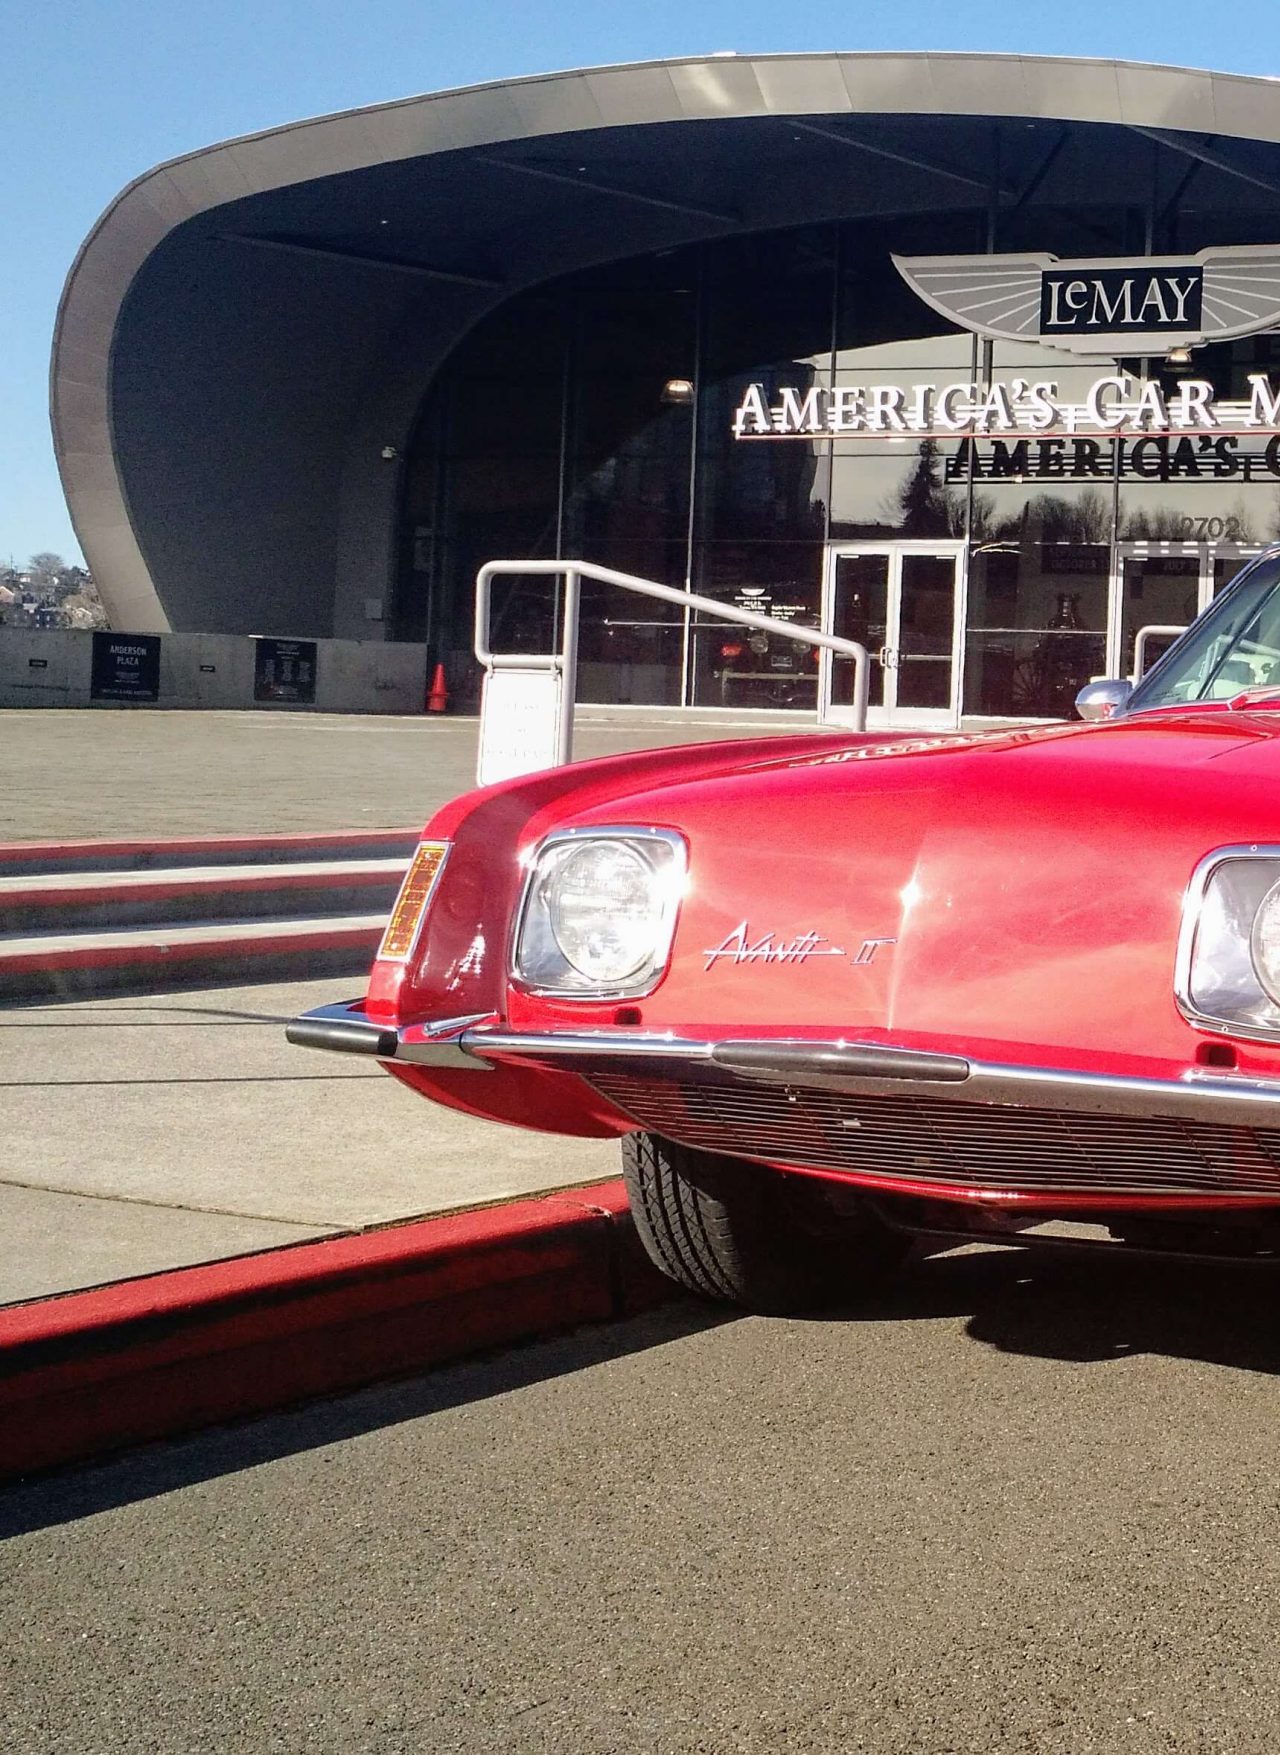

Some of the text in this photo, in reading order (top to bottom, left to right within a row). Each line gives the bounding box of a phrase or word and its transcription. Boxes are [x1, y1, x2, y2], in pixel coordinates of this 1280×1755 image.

[1046, 277, 1199, 325] LeMAY
[732, 378, 1060, 432] AMERICA'S
[1086, 375, 1220, 429] CAR
[109, 644, 147, 656] ANDERSON
